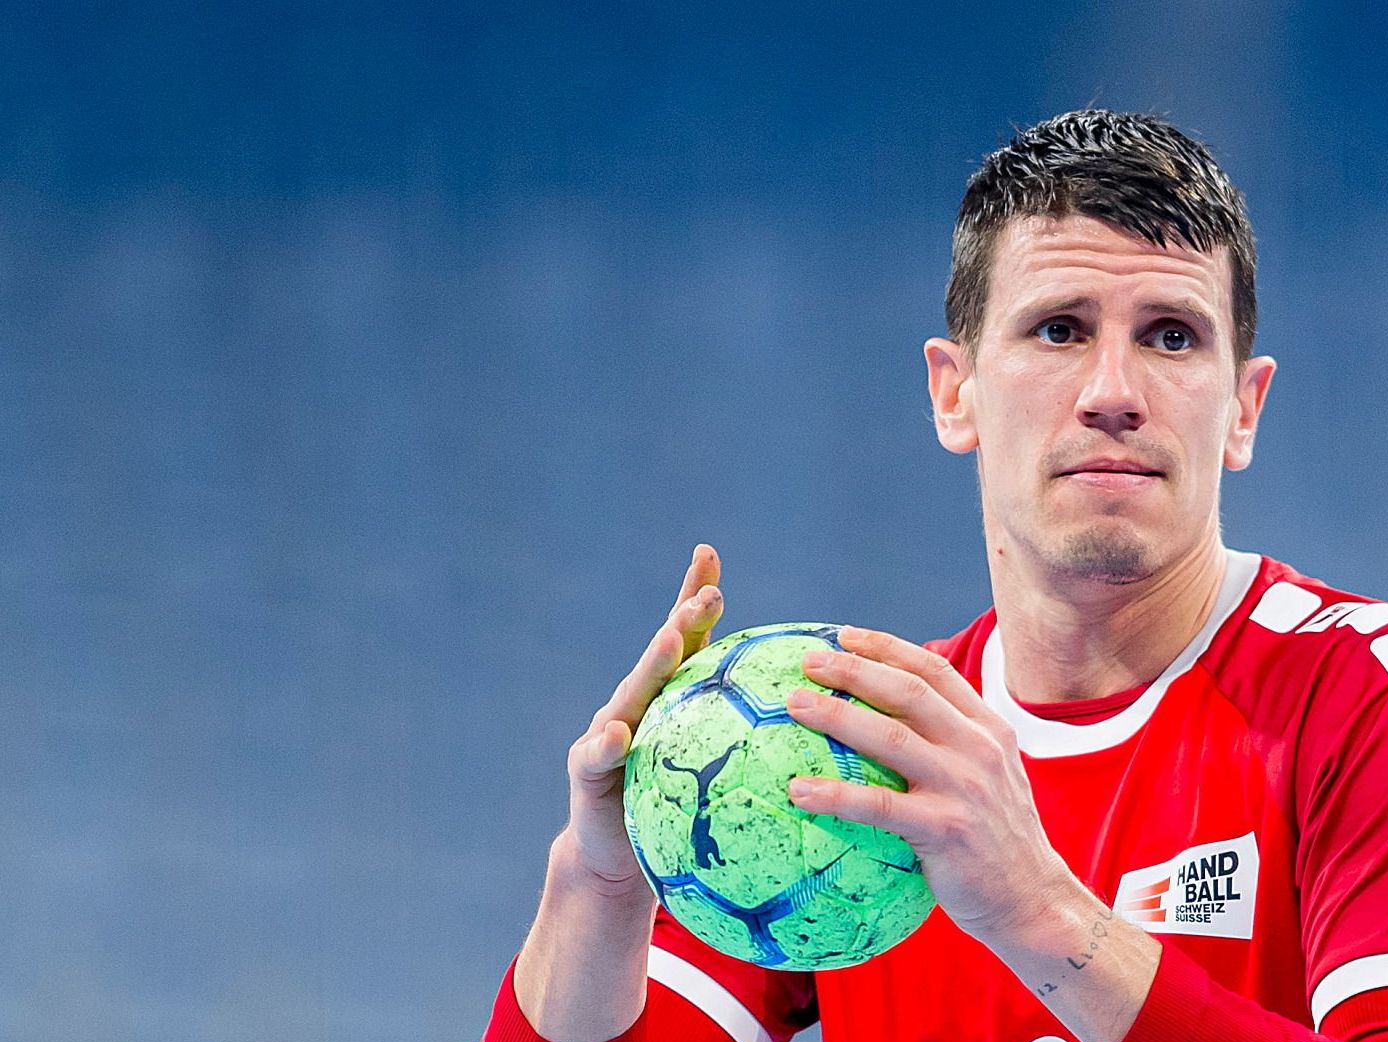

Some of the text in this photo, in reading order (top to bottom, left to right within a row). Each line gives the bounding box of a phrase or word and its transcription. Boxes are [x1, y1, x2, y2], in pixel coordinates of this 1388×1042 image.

[1177, 851, 1239, 886] HAND
[1185, 877, 1241, 903] BALL
[1175, 902, 1226, 914] SCHWEIZ
[1175, 913, 1212, 923] SUISSE
